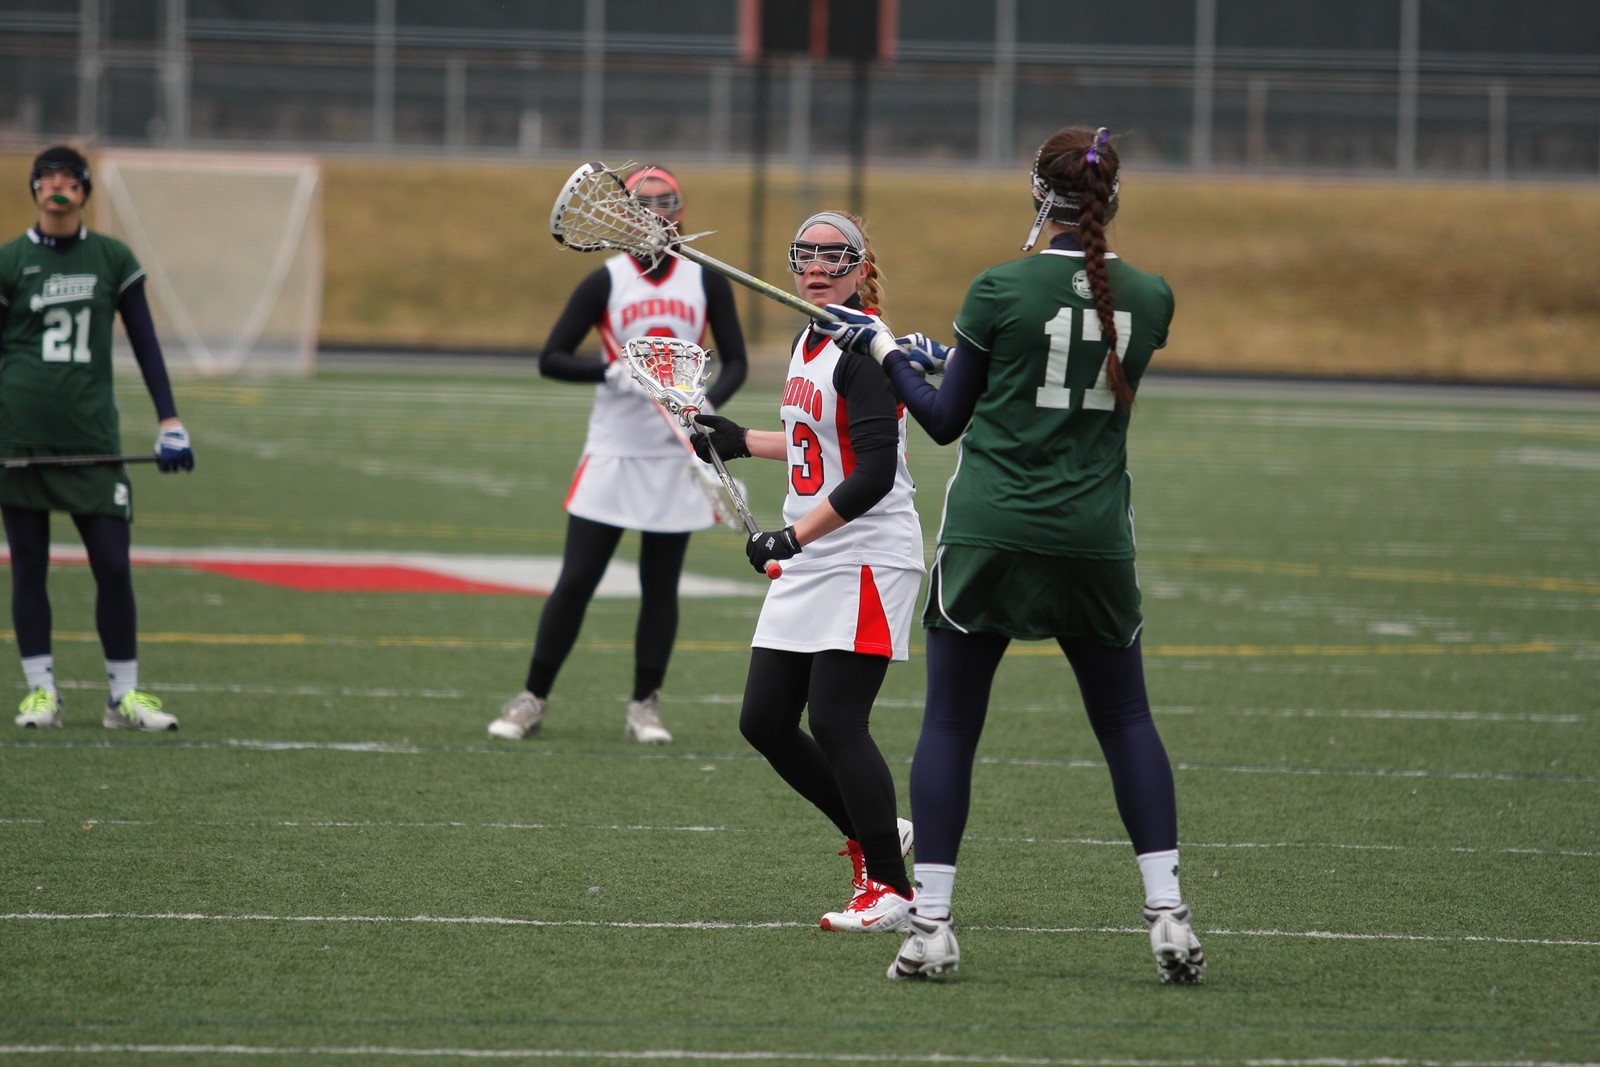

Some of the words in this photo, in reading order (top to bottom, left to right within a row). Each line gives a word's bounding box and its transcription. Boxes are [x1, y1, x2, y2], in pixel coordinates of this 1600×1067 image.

[42, 307, 92, 363] 21
[1035, 306, 1132, 411] 17
[783, 420, 825, 496] 3
